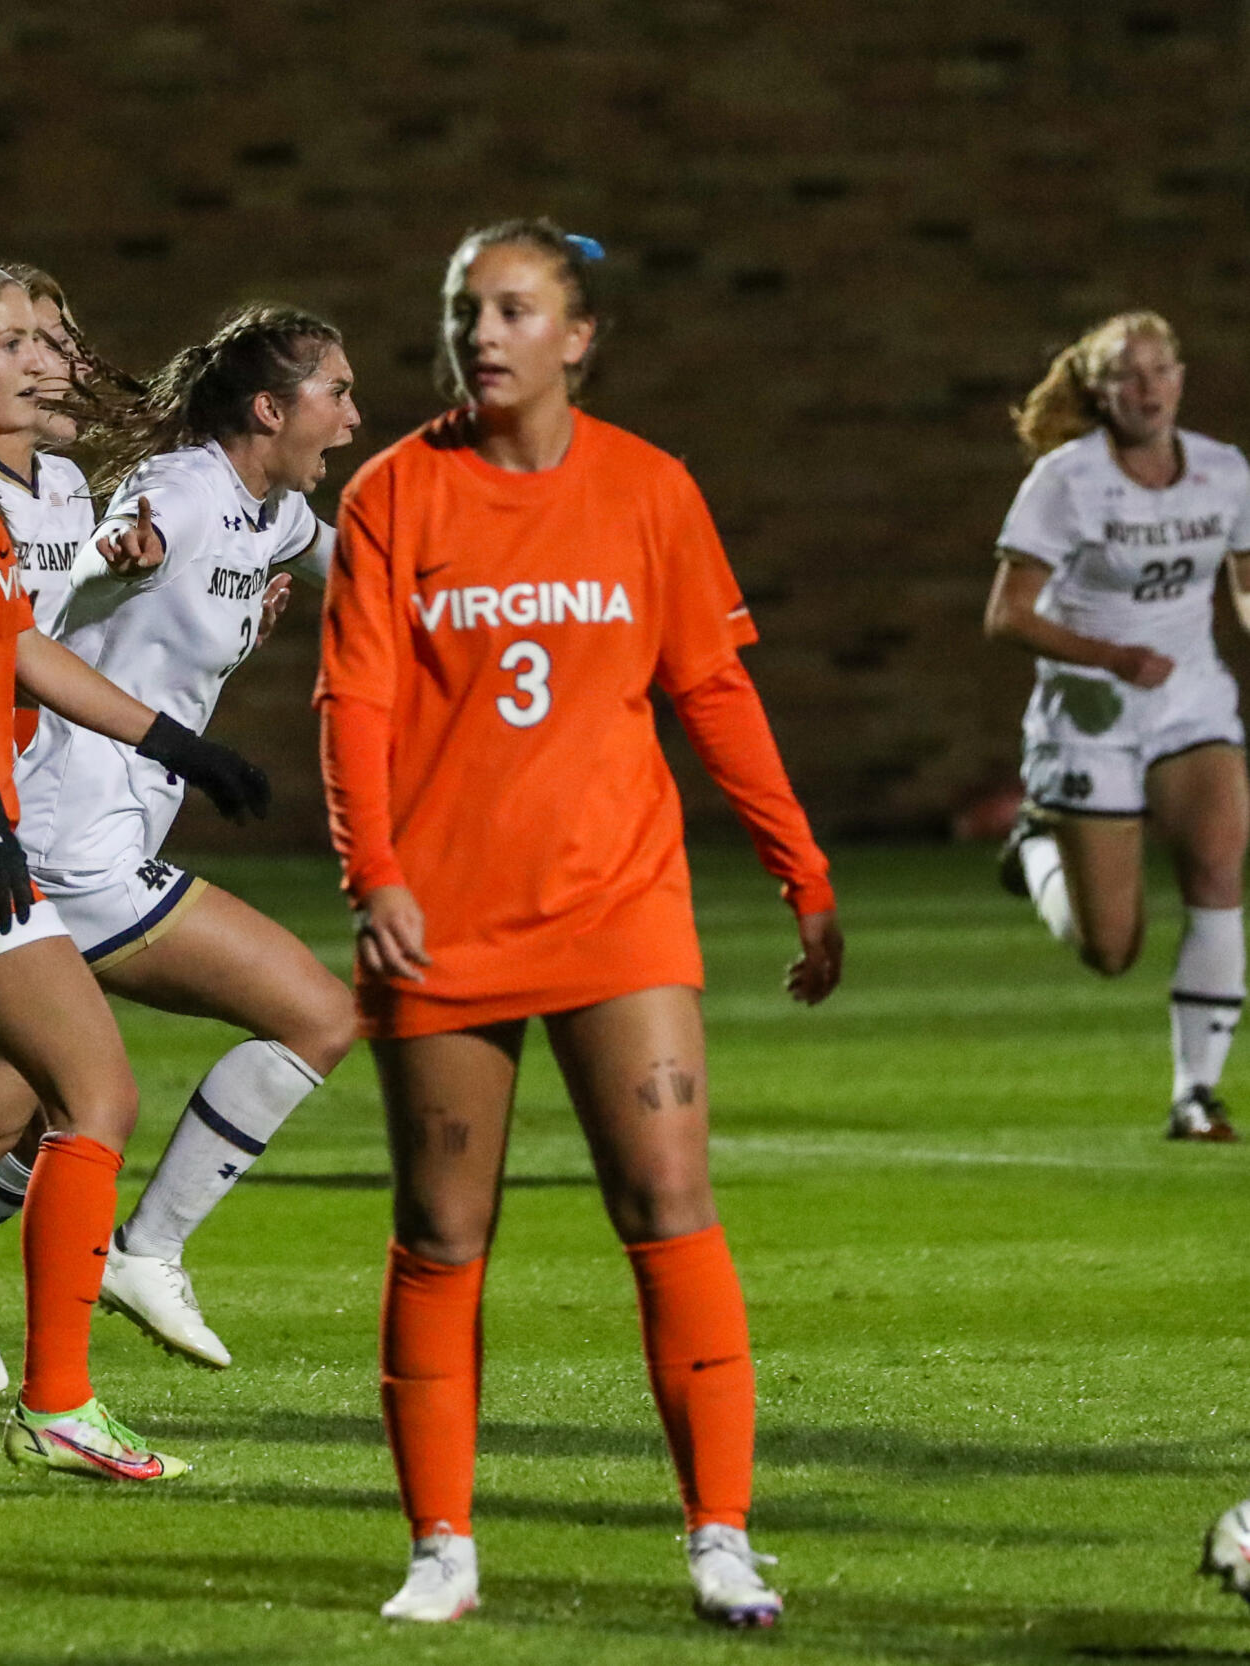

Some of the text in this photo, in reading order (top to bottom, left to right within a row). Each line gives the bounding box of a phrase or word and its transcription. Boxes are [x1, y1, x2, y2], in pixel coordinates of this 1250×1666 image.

[1133, 556, 1195, 602] 22
[410, 580, 634, 634] VIRGINIA
[496, 639, 552, 729] 3
